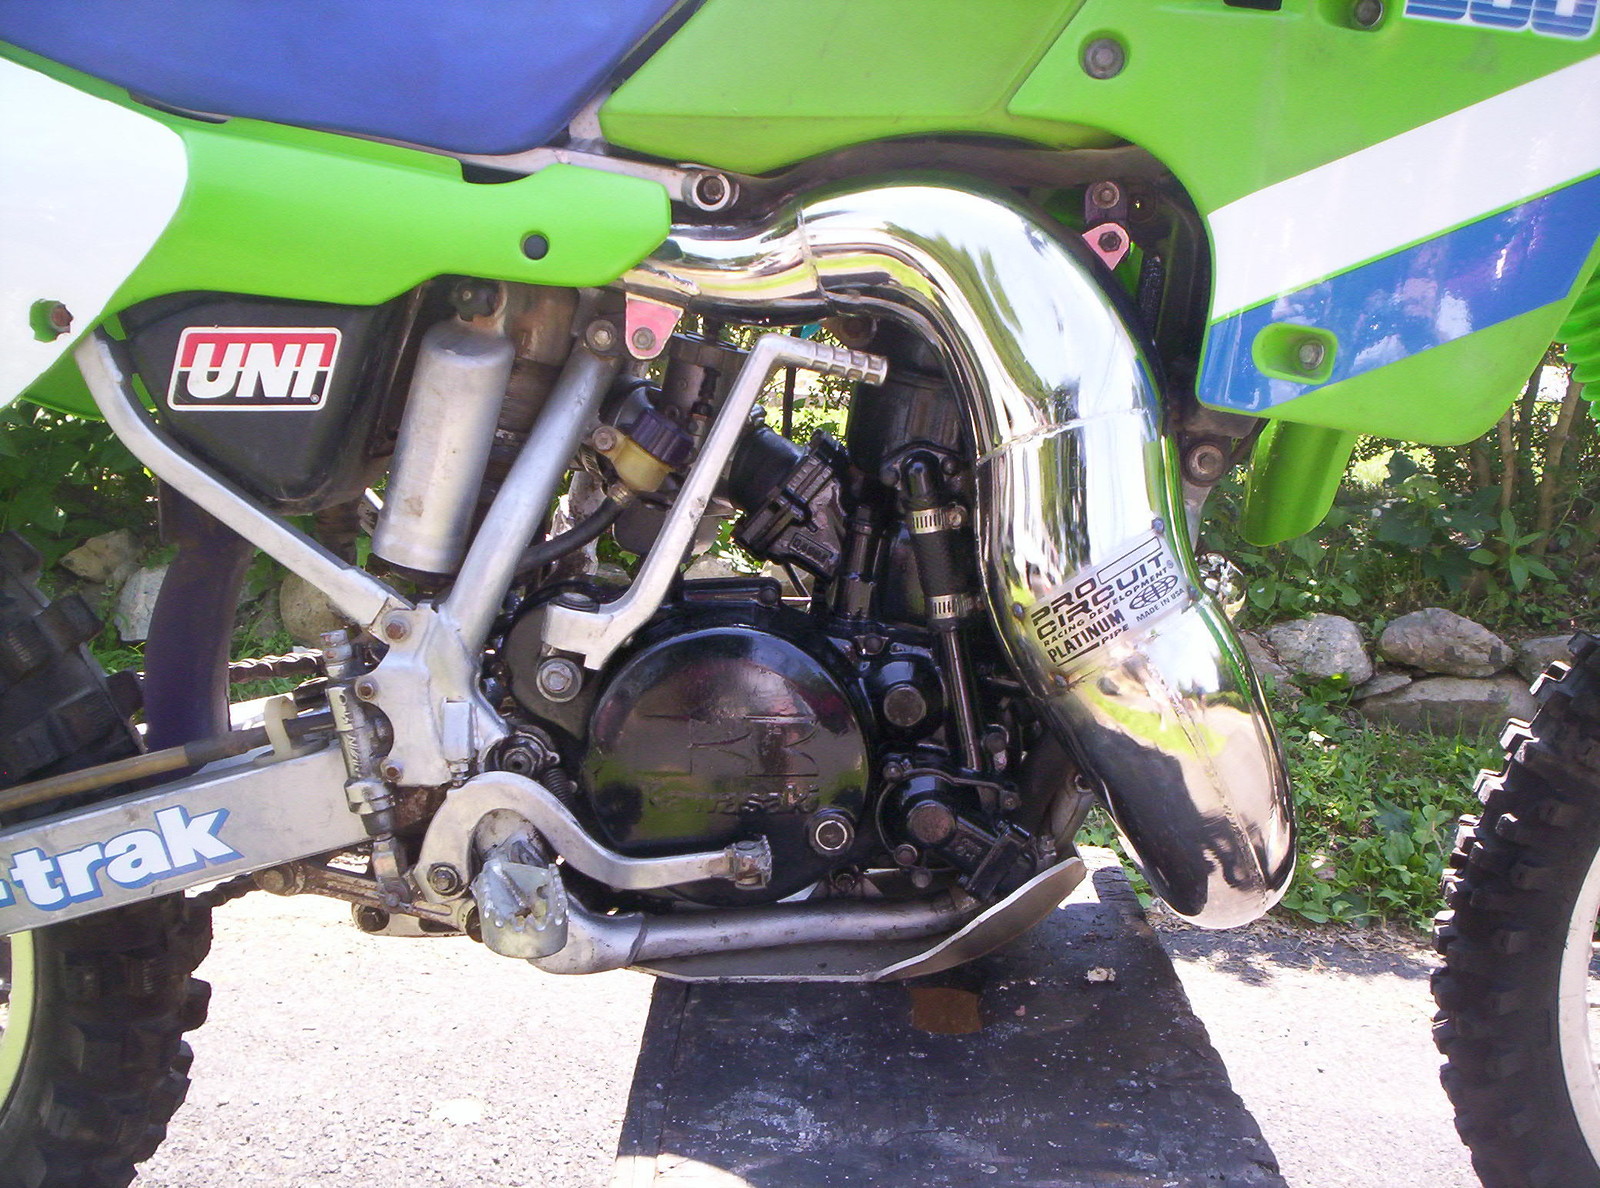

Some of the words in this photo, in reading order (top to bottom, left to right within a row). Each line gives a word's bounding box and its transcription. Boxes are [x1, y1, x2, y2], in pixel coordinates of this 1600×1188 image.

[187, 343, 326, 399] UNI
[1031, 578, 1097, 627] PRO
[1037, 552, 1165, 640] CIRCUIT
[1044, 619, 1086, 647] RACING
[1089, 567, 1168, 620] DEVELOPMENT
[1136, 604, 1160, 622] MADE
[1160, 597, 1171, 607] IN
[1171, 587, 1185, 600] USA
[1047, 608, 1126, 663] PLATINUM
[1101, 623, 1130, 645] PIPE
